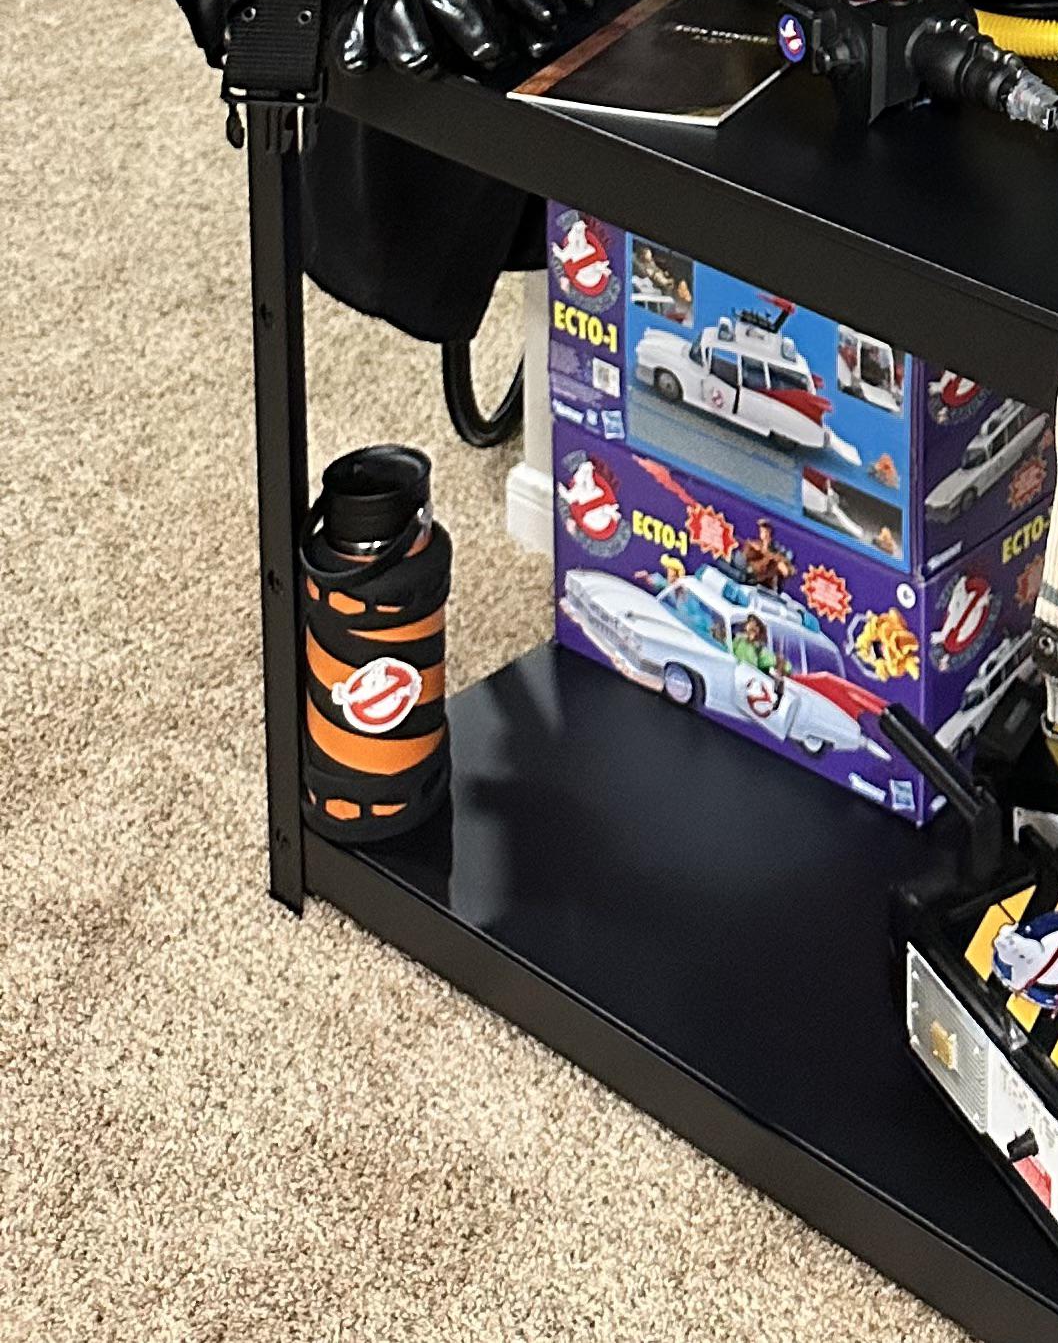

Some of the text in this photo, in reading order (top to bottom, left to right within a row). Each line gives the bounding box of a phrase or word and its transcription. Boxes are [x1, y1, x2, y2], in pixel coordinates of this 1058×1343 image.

[553, 300, 618, 354] ECTO-1
[632, 509, 688, 557] ECTO-1
[1002, 512, 1051, 565] ECTO-
